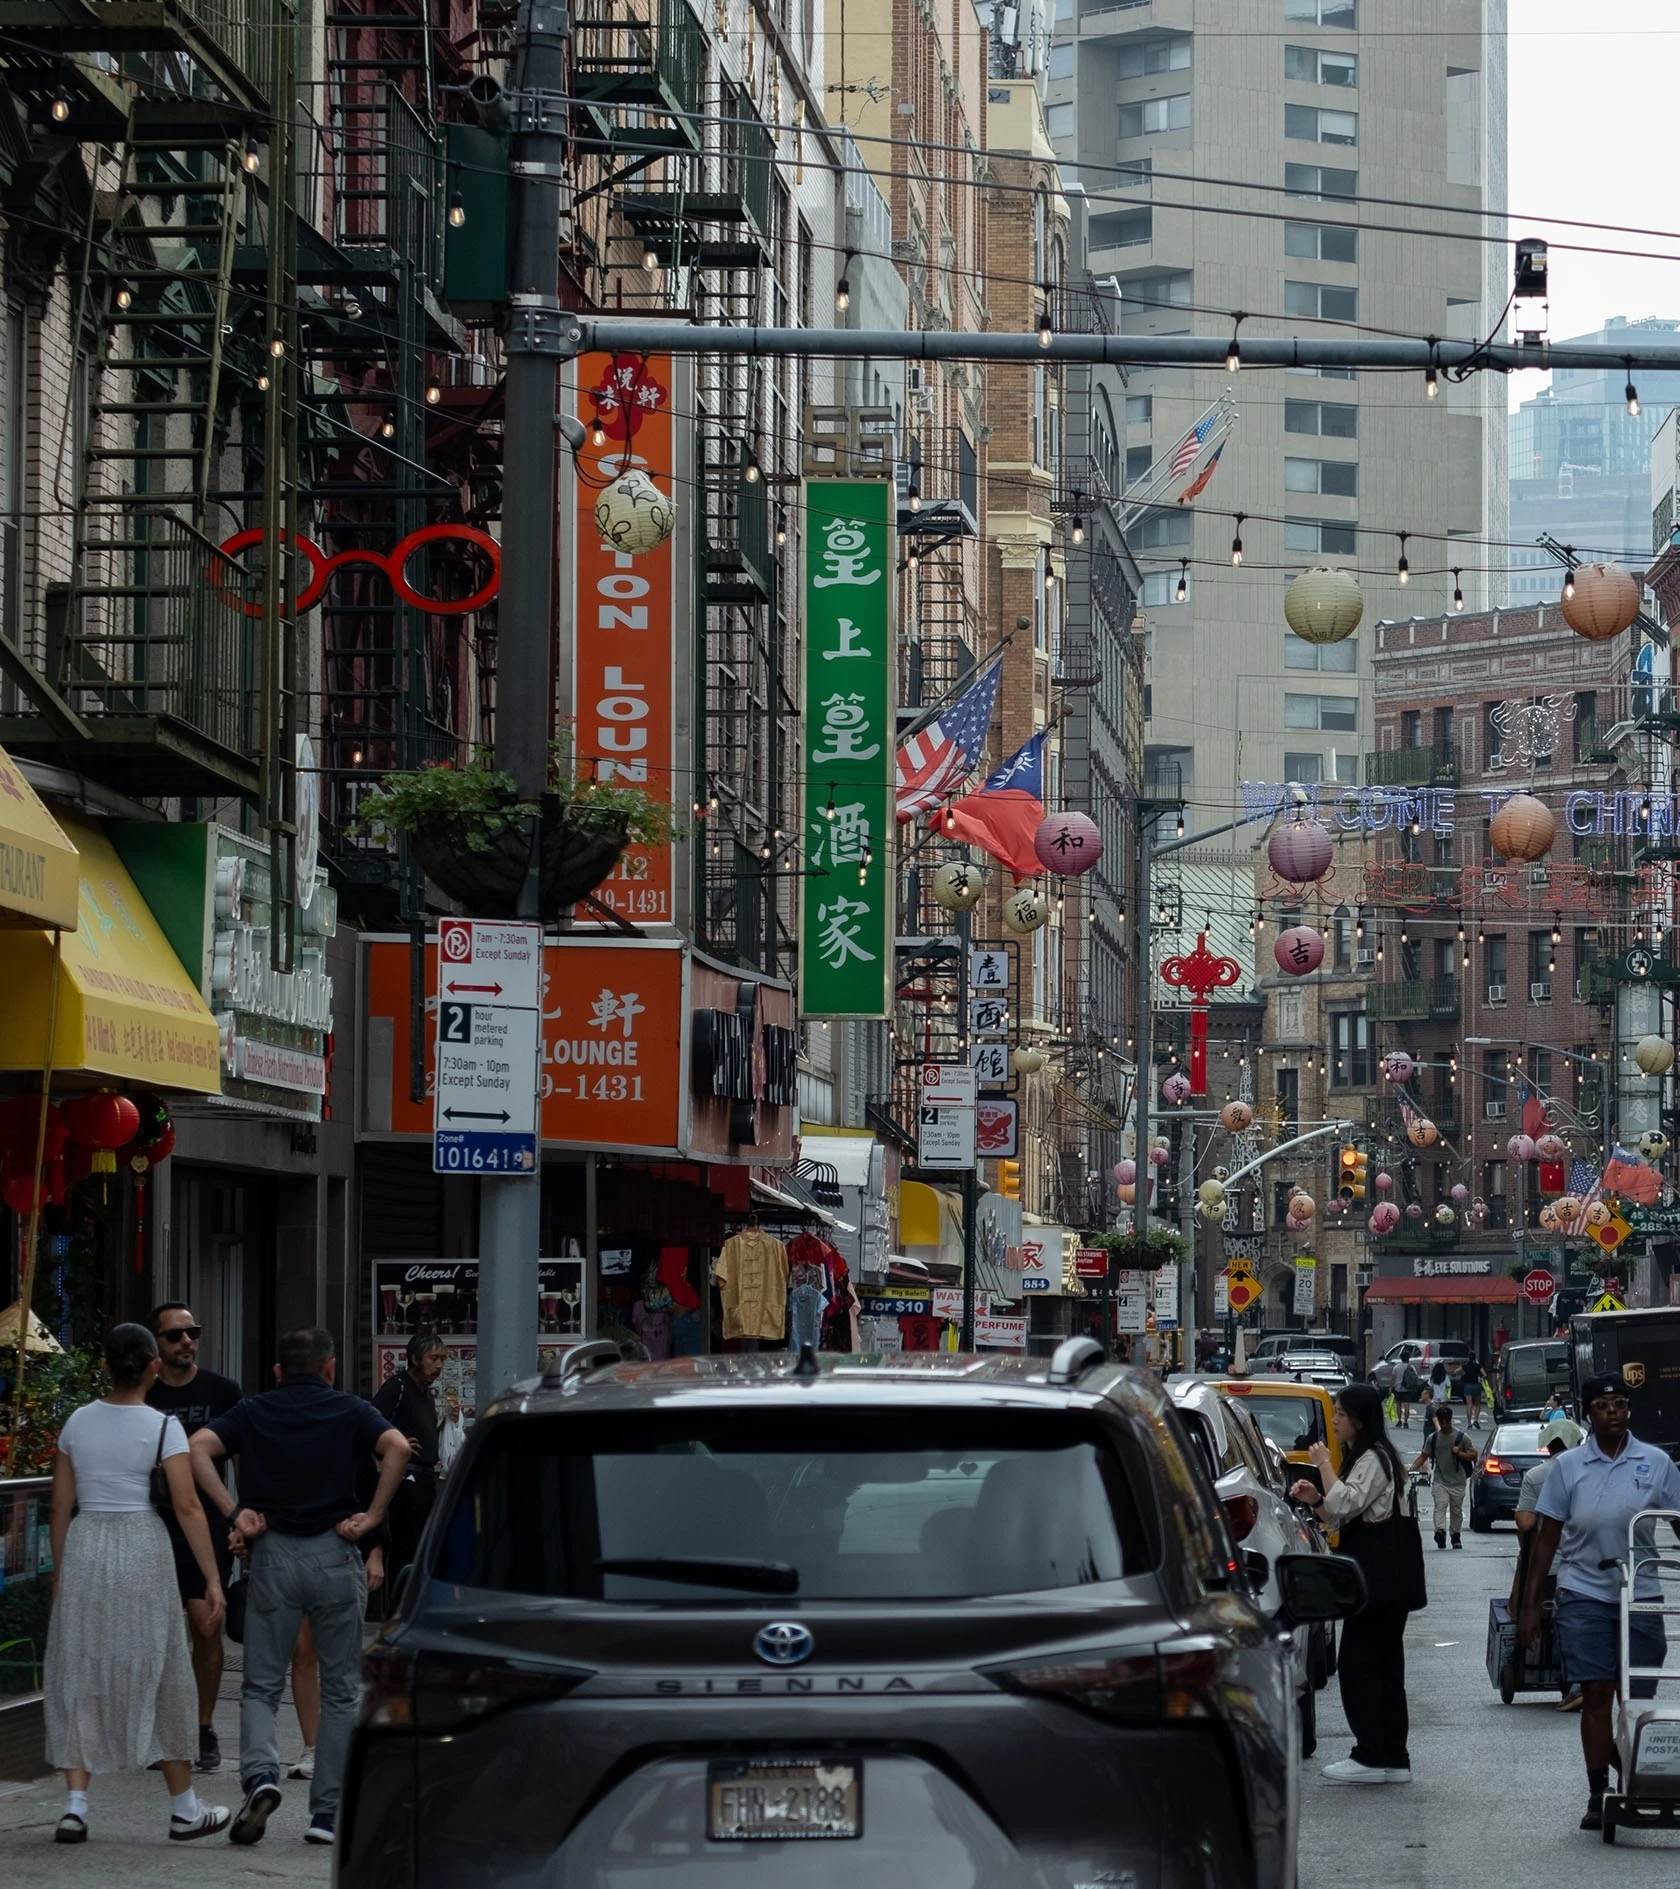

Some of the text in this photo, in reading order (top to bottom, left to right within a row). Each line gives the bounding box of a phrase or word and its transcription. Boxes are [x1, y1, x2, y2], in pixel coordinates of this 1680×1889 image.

[1242, 781, 1456, 831] WELCOME
[1051, 826, 1084, 854] 和
[1014, 901, 1037, 924] 福
[476, 932, 528, 945] 7am 7:30am
[475, 949, 531, 963] Except Sunday
[1288, 938, 1310, 965] 吉
[447, 1006, 493, 1040] 2 hour
[474, 1023, 508, 1034] metered
[474, 1036, 504, 1048] parking
[442, 1057, 510, 1074] 7:30am 10pm
[442, 1074, 511, 1091] Except Sunday
[924, 1107, 934, 1124] 2
[942, 1140, 960, 1148] Sunday
[438, 1146, 508, 1169] 101641
[404, 1265, 461, 1282] Cheers!
[1435, 1262, 1448, 1273] EYE
[1450, 1261, 1490, 1273] SOLUTIONS
[1024, 1279, 1046, 1289] 884
[1298, 1280, 1312, 1289] 20
[1526, 1279, 1552, 1292] STOP
[936, 1290, 980, 1302] WATH
[870, 1300, 924, 1313] for $10
[975, 1320, 1025, 1331] PERFUME
[1625, 1369, 1644, 1385] ups
[655, 1676, 914, 1694] SIENNA
